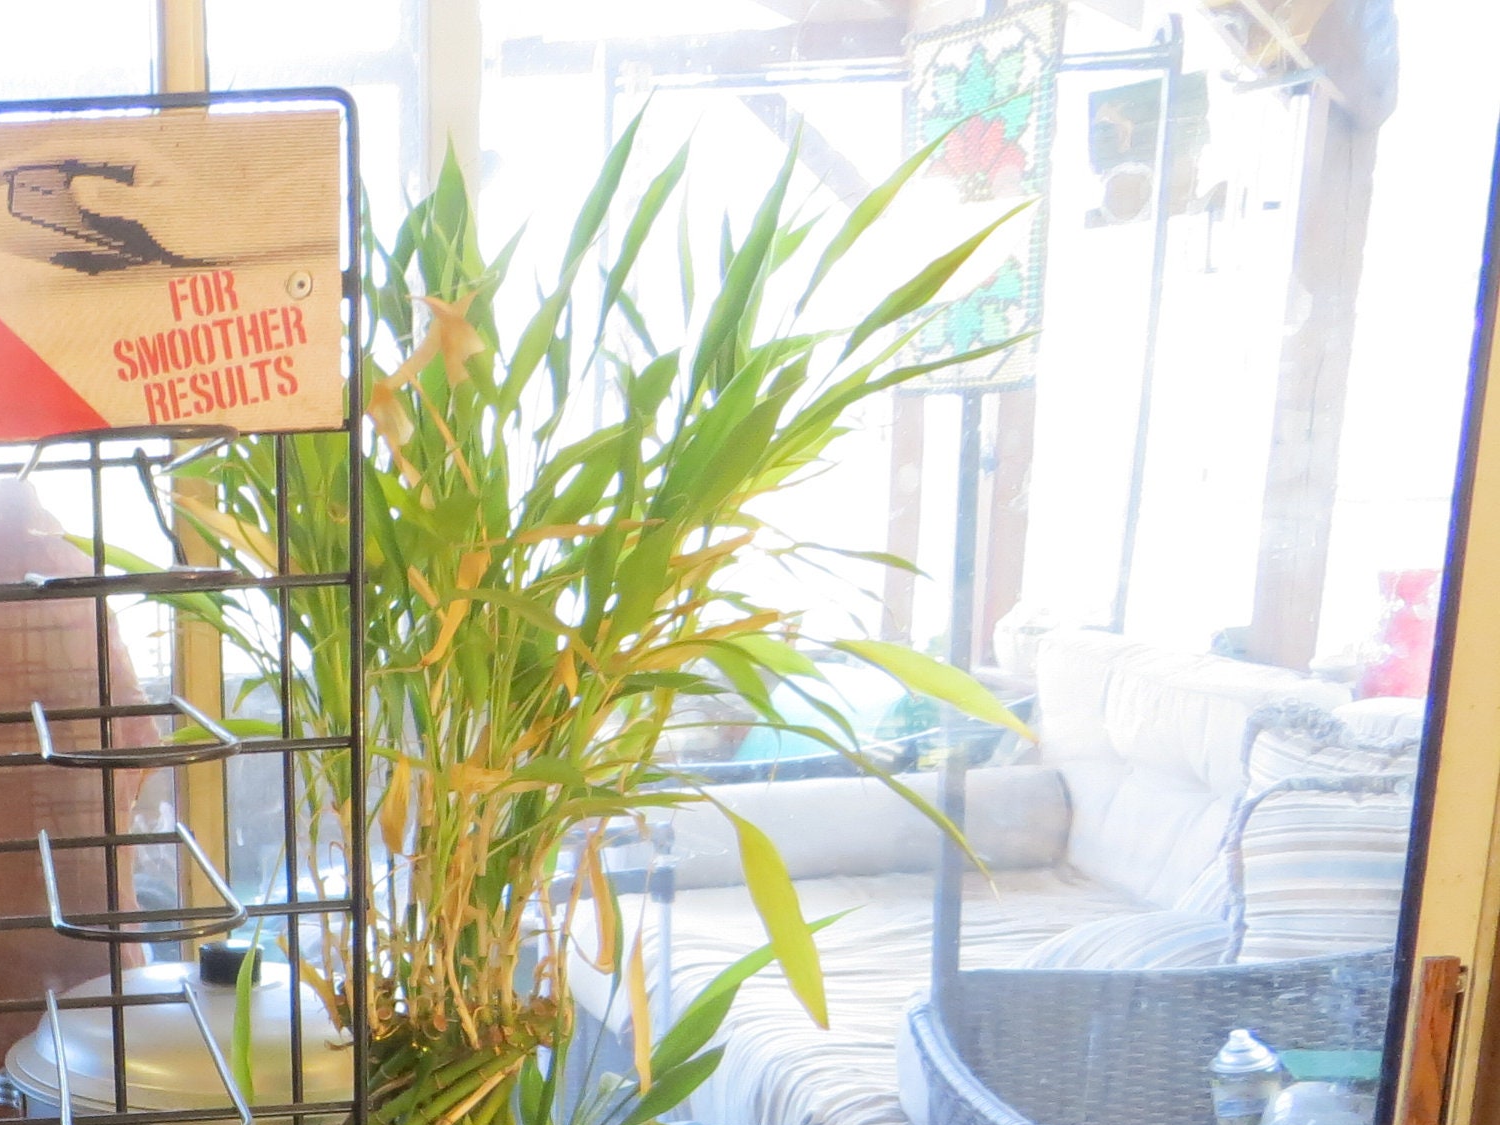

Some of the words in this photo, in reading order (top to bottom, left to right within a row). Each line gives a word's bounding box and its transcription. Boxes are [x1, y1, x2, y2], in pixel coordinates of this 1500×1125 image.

[168, 269, 239, 322] FOR
[113, 306, 307, 382] SMOOTHER
[143, 355, 298, 426] RESULTS
